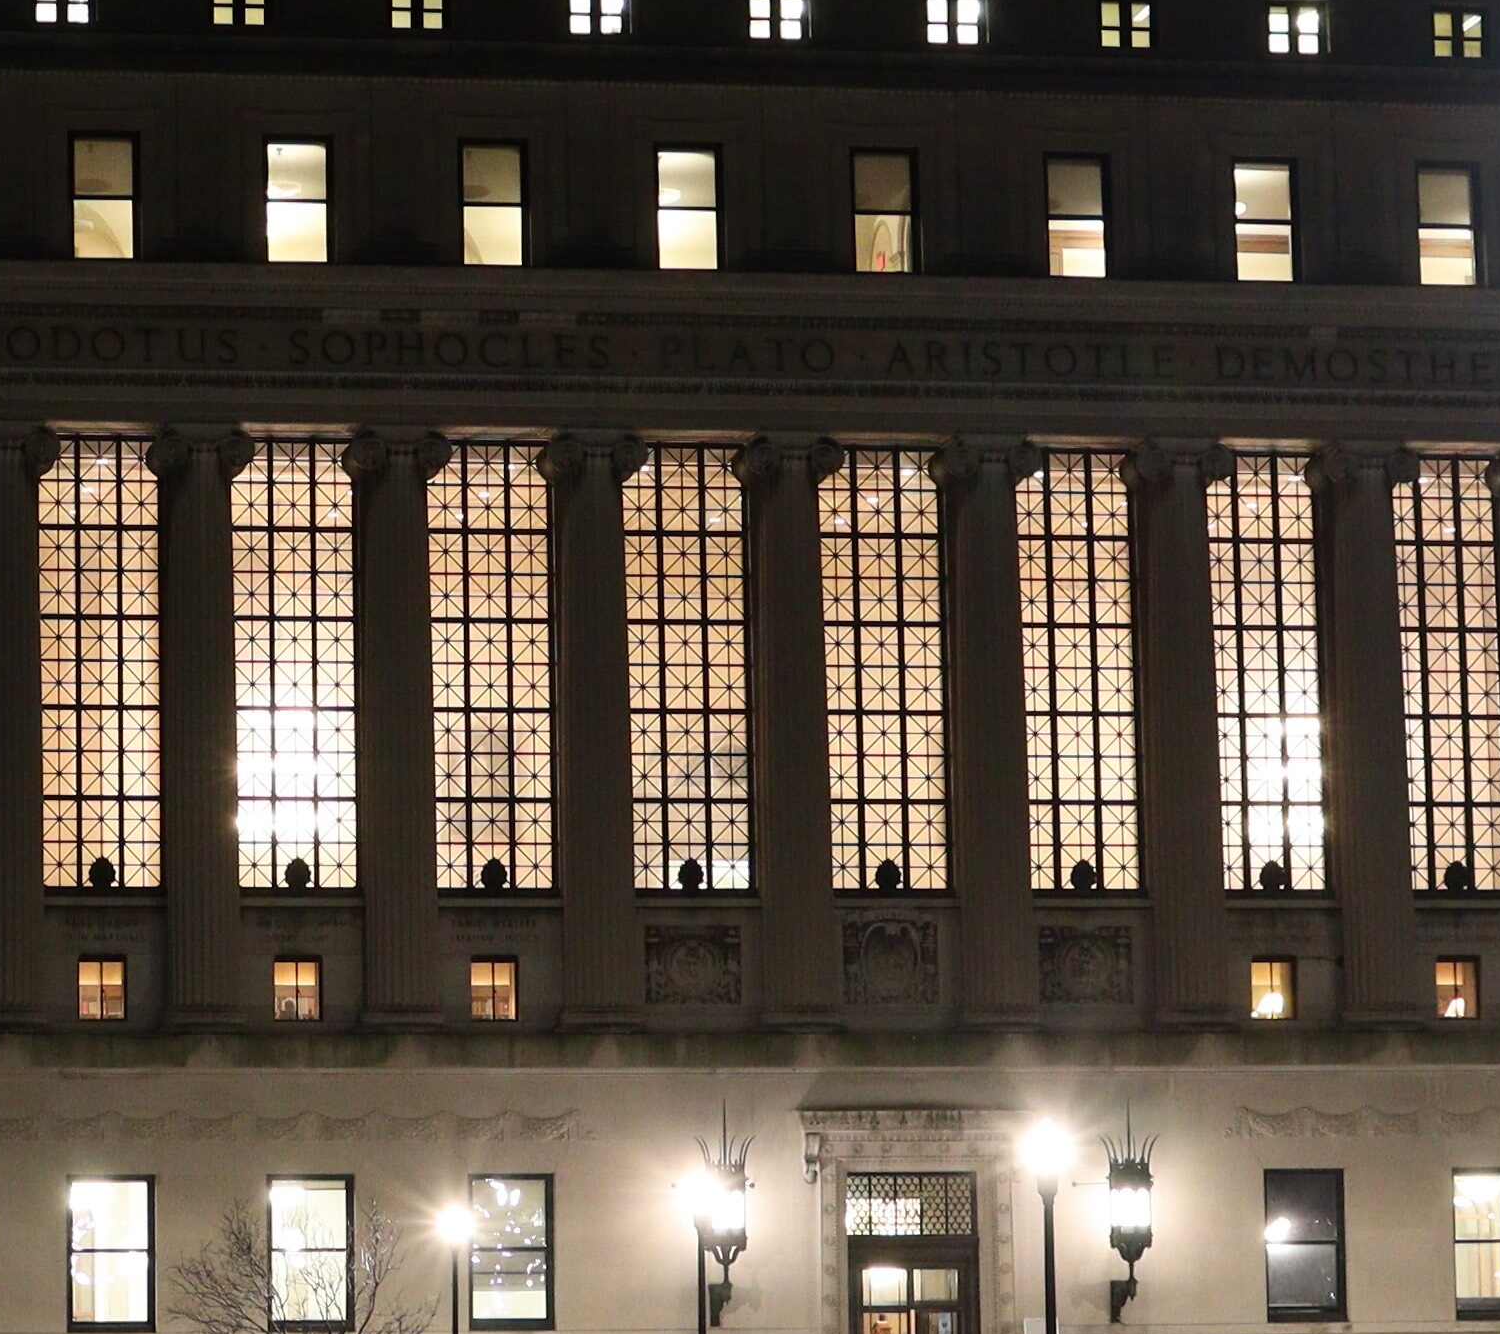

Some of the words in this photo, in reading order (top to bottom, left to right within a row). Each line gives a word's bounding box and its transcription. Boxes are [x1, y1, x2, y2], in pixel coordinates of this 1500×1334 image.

[288, 329, 611, 369] SOPHOCLES
[658, 336, 836, 373] PLATO
[885, 338, 1178, 380] ARISTOTLE
